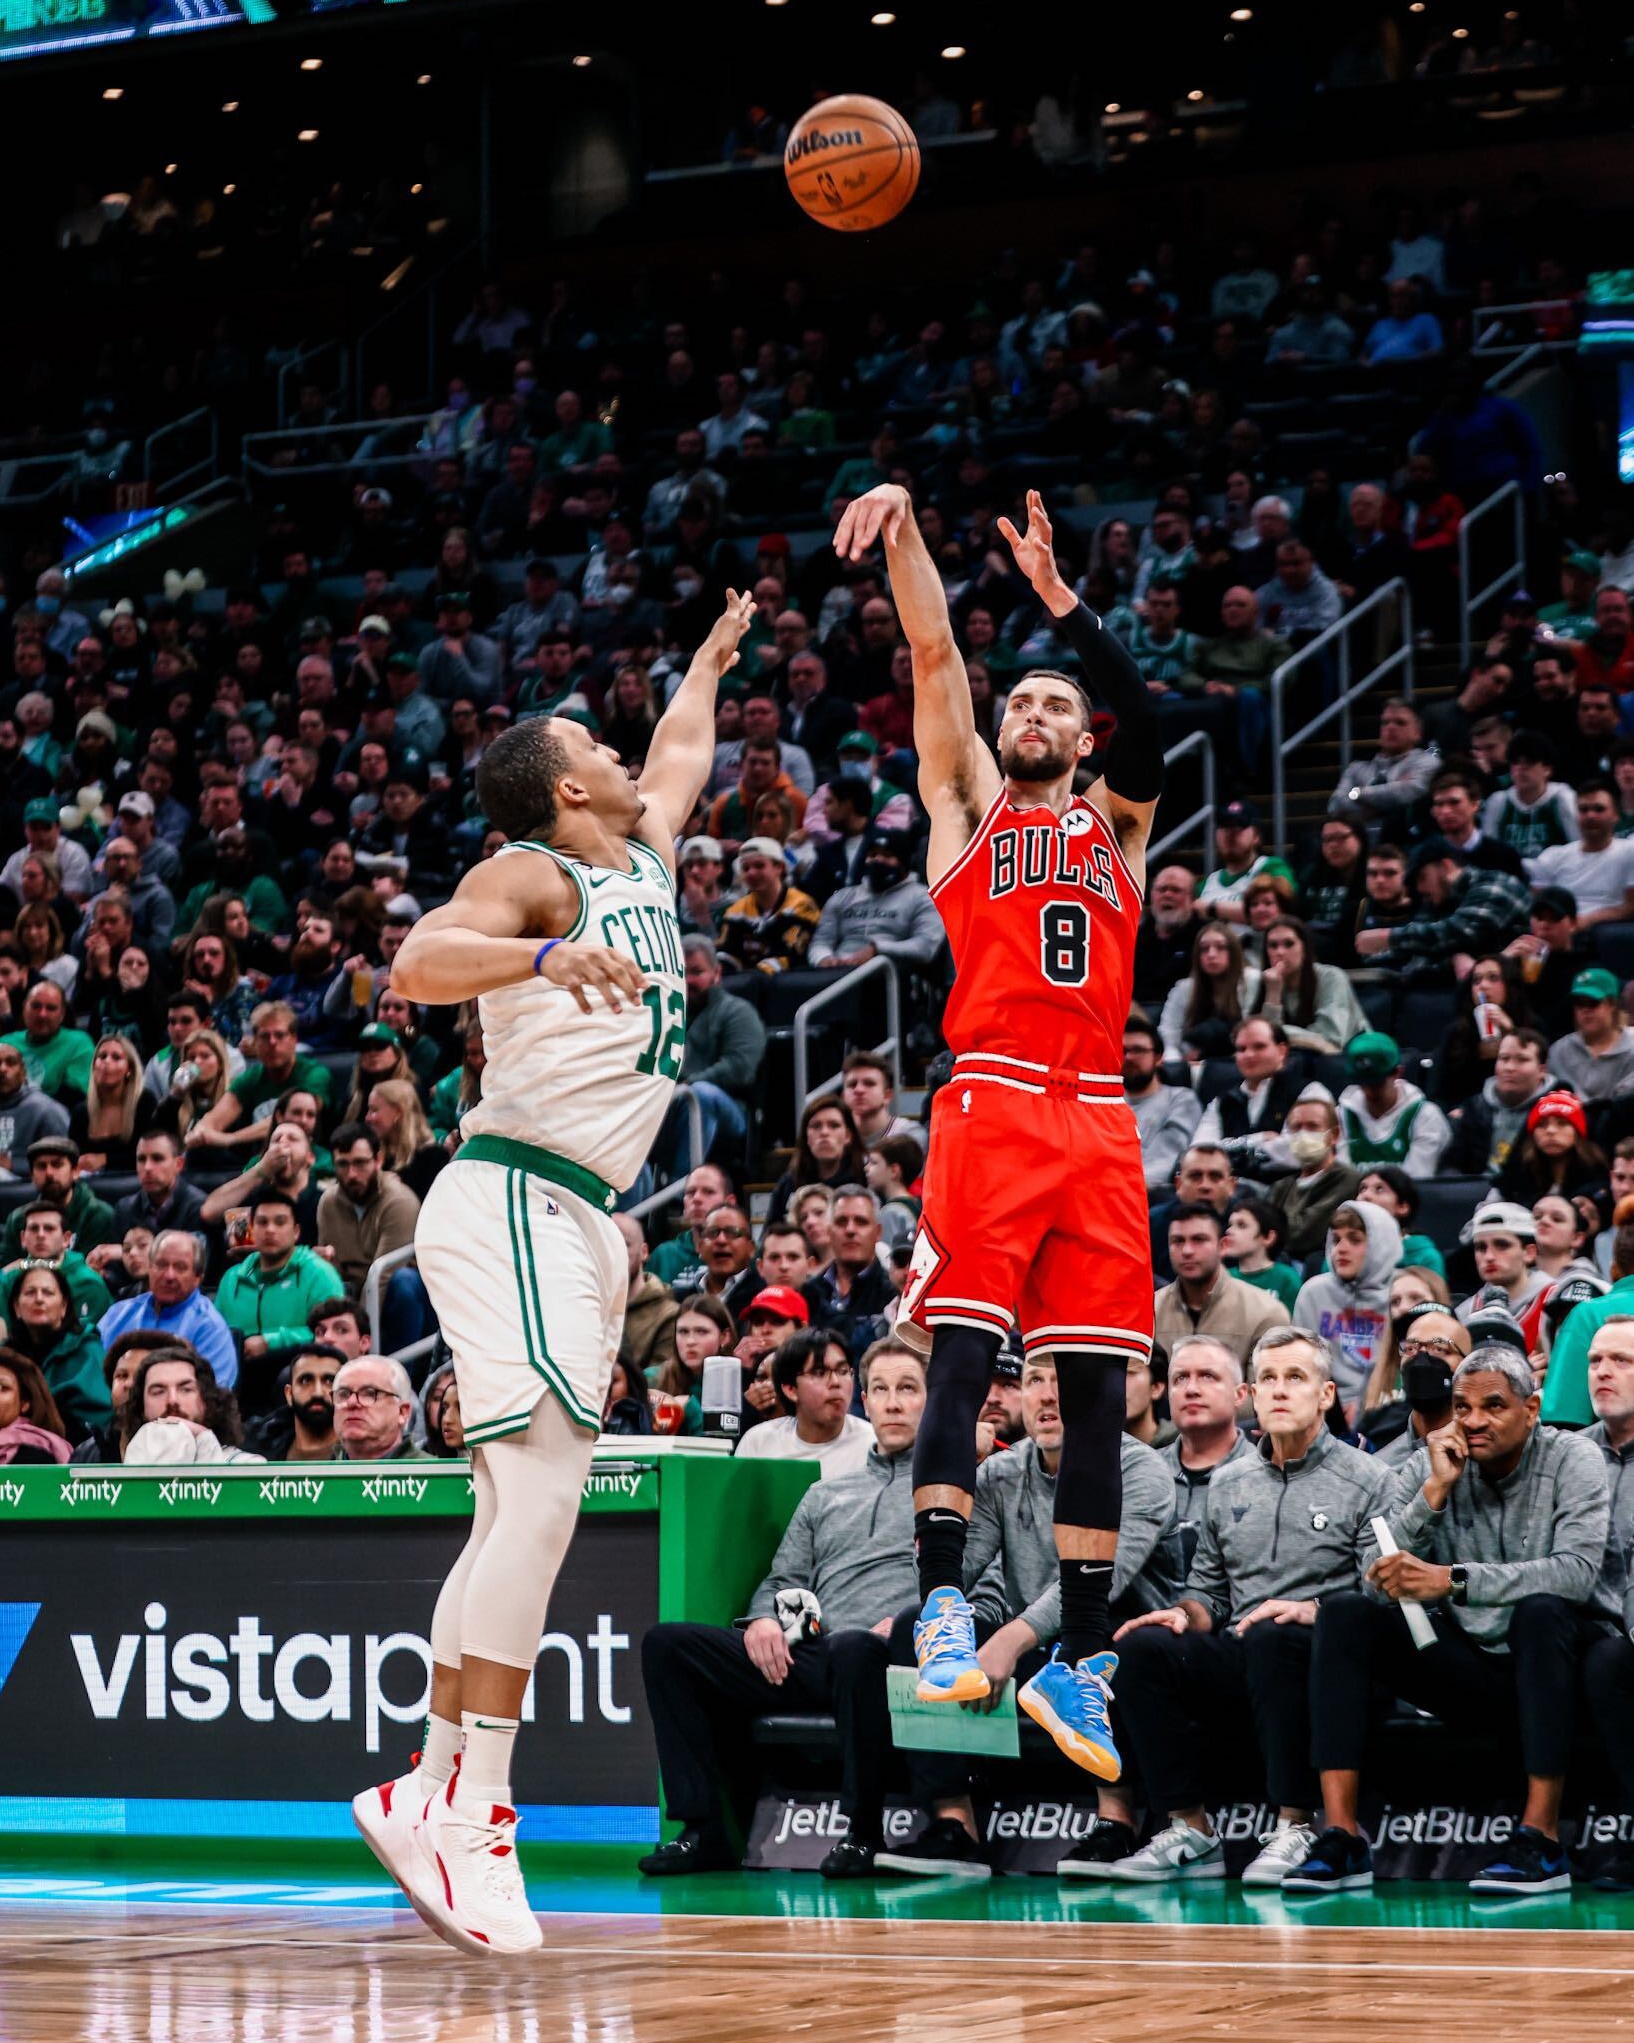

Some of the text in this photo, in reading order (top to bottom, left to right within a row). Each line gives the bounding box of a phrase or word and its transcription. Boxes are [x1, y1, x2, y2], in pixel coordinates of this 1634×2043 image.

[600, 905, 685, 978] CELTIC
[1040, 900, 1090, 988] 8
[635, 985, 685, 1081] 12
[59, 1477, 123, 1507] xfinity
[158, 1476, 223, 1506] xfinity
[259, 1474, 325, 1504] xfinity
[361, 1473, 428, 1503] xfinity
[582, 1471, 642, 1499] finity
[70, 1601, 633, 1753] vistapnt
[986, 1801, 1098, 1842] jetBlu
[1371, 1804, 1512, 1850] jetBlue
[1576, 1804, 1634, 1850] jet
